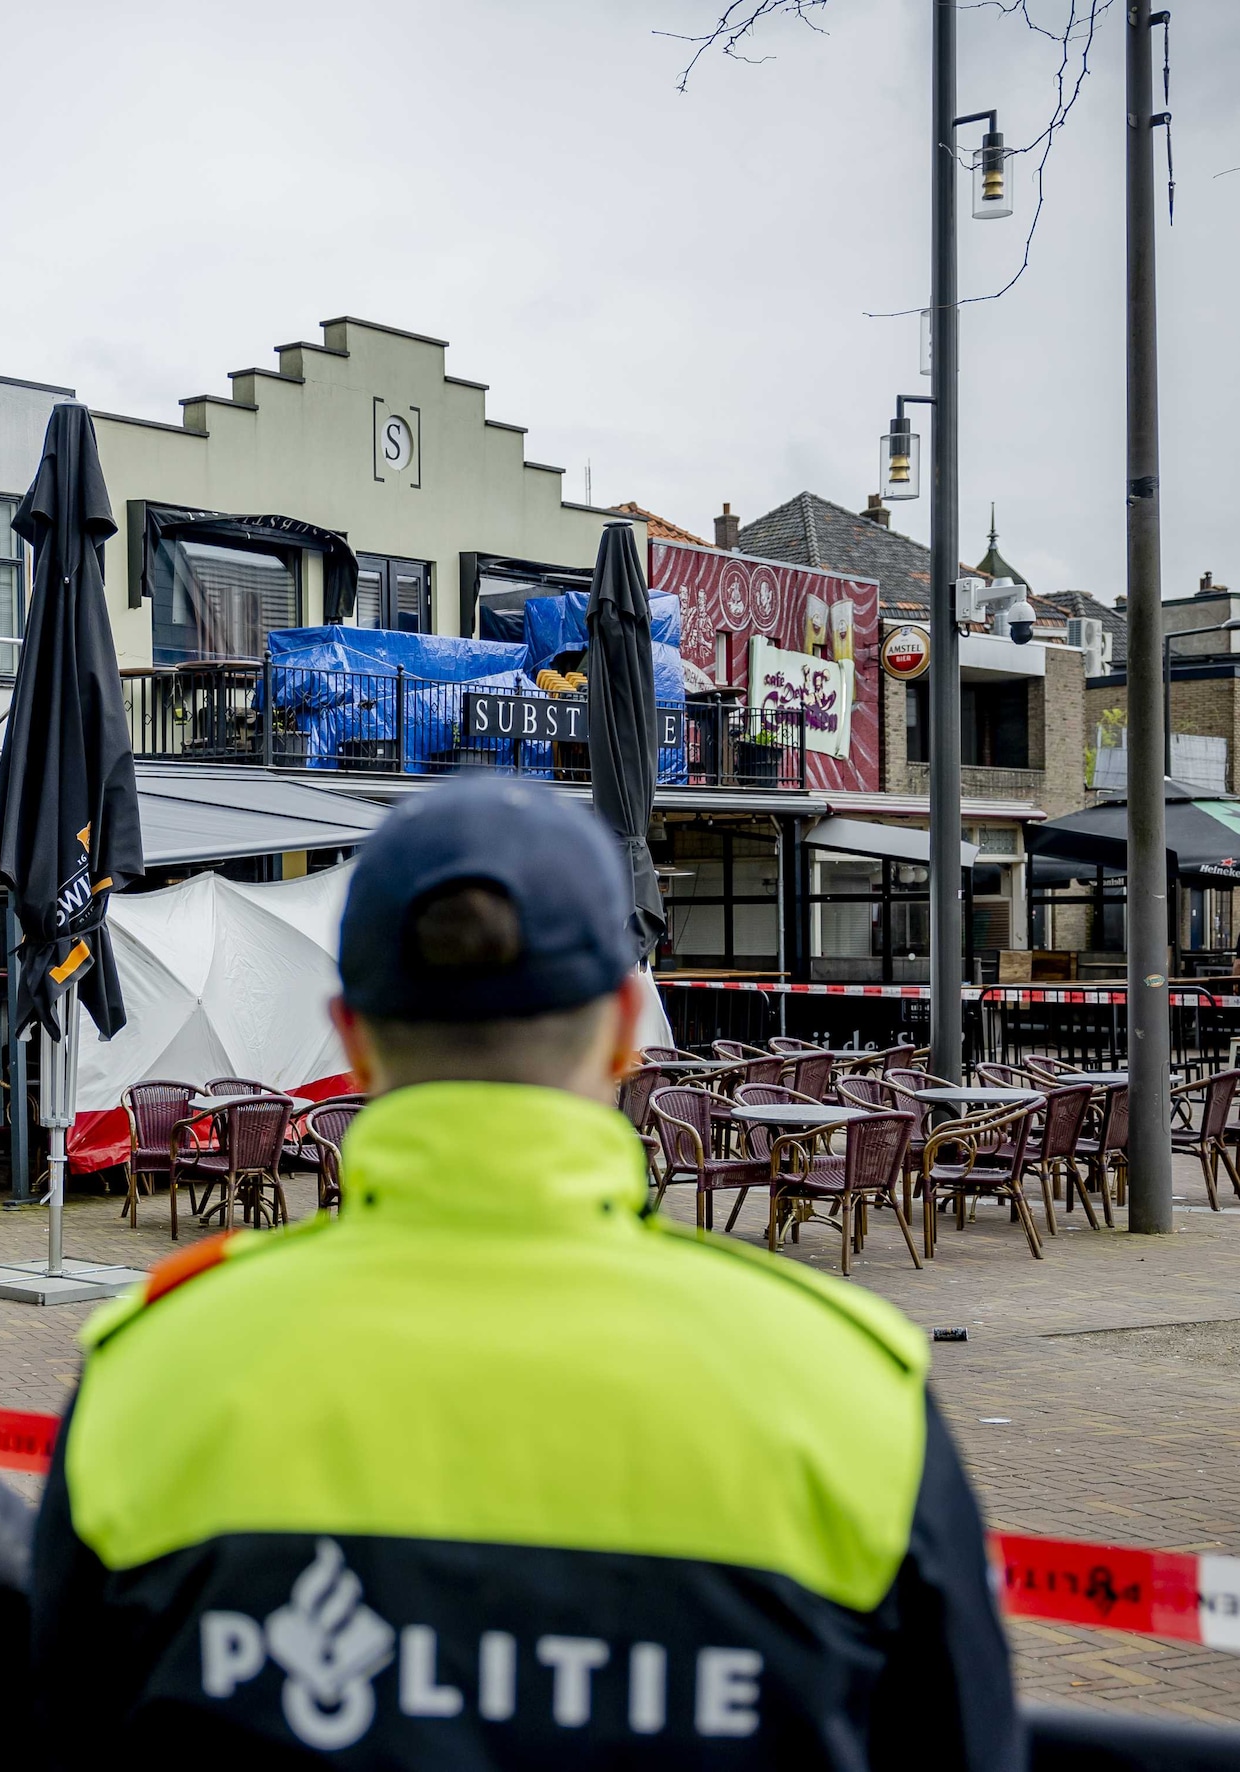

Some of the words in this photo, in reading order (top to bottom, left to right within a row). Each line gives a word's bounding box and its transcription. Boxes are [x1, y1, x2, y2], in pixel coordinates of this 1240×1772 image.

[888, 644, 922, 654] AMSTEL
[895, 655, 912, 663] BIER
[198, 1535, 764, 1752] POLITIE
